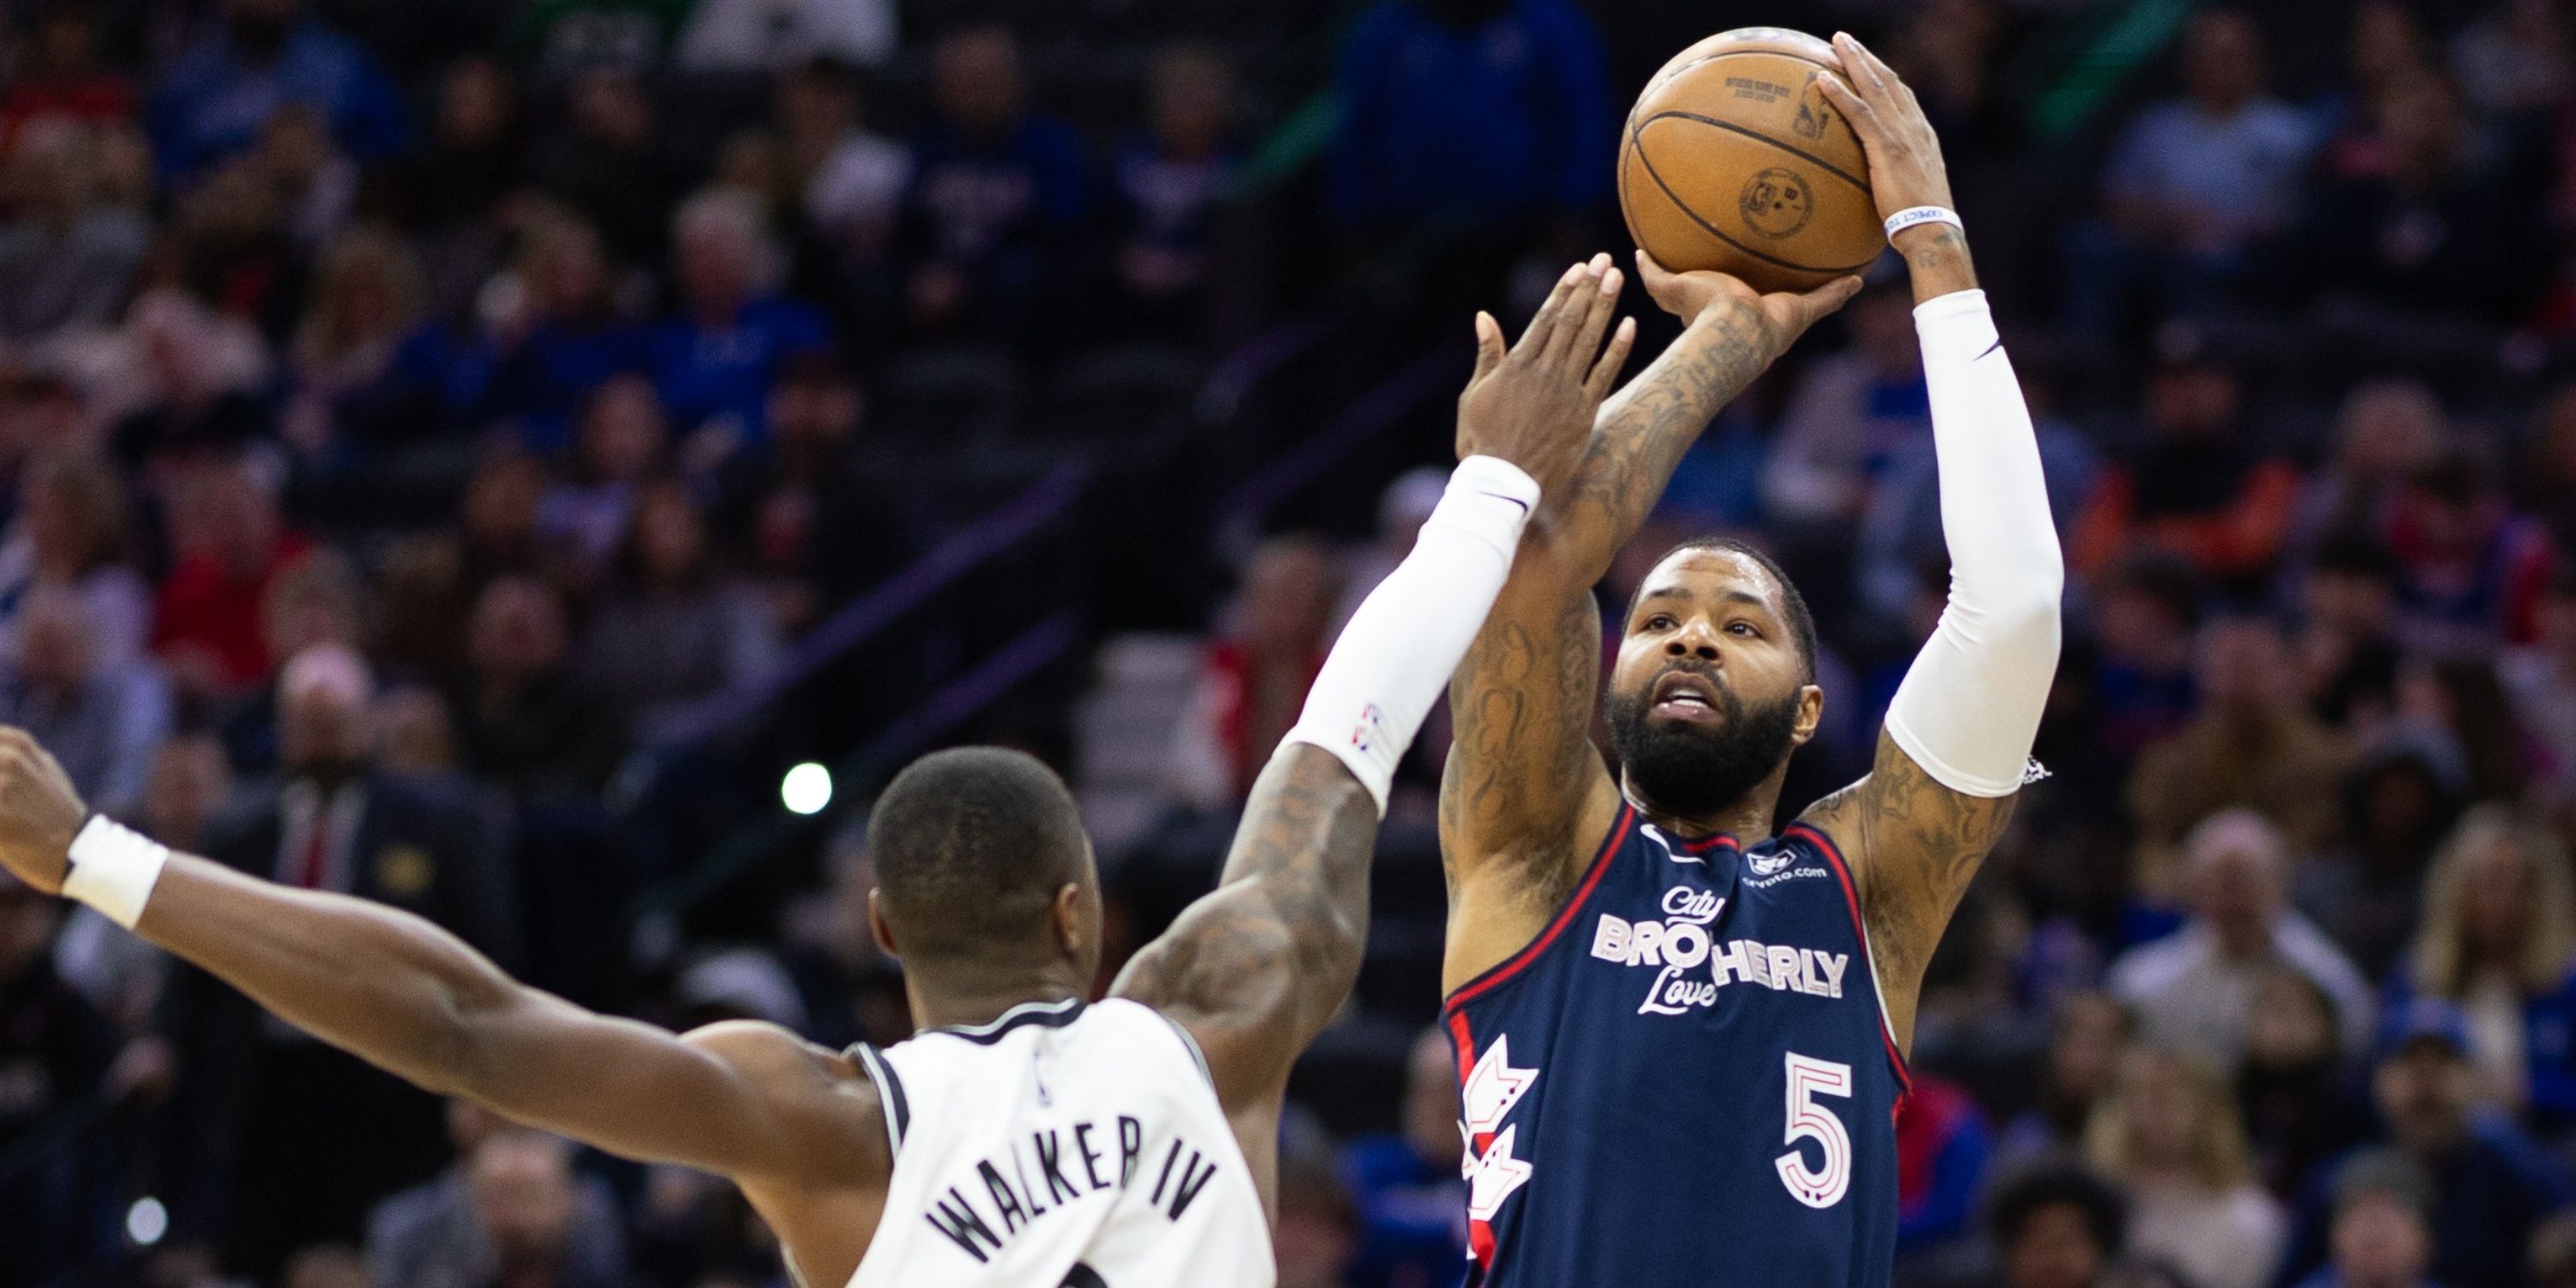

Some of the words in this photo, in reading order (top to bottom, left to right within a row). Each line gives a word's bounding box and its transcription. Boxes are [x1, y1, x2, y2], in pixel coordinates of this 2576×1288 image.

[1662, 885, 1726, 927] City
[1741, 867, 1827, 889] crypto.com
[1590, 913, 1850, 999] BROHERLY
[1637, 964, 1717, 1016] Love
[1775, 1051, 1852, 1210] 5
[925, 1115, 1141, 1264] WALKER
[1150, 1138, 1218, 1222] IV
